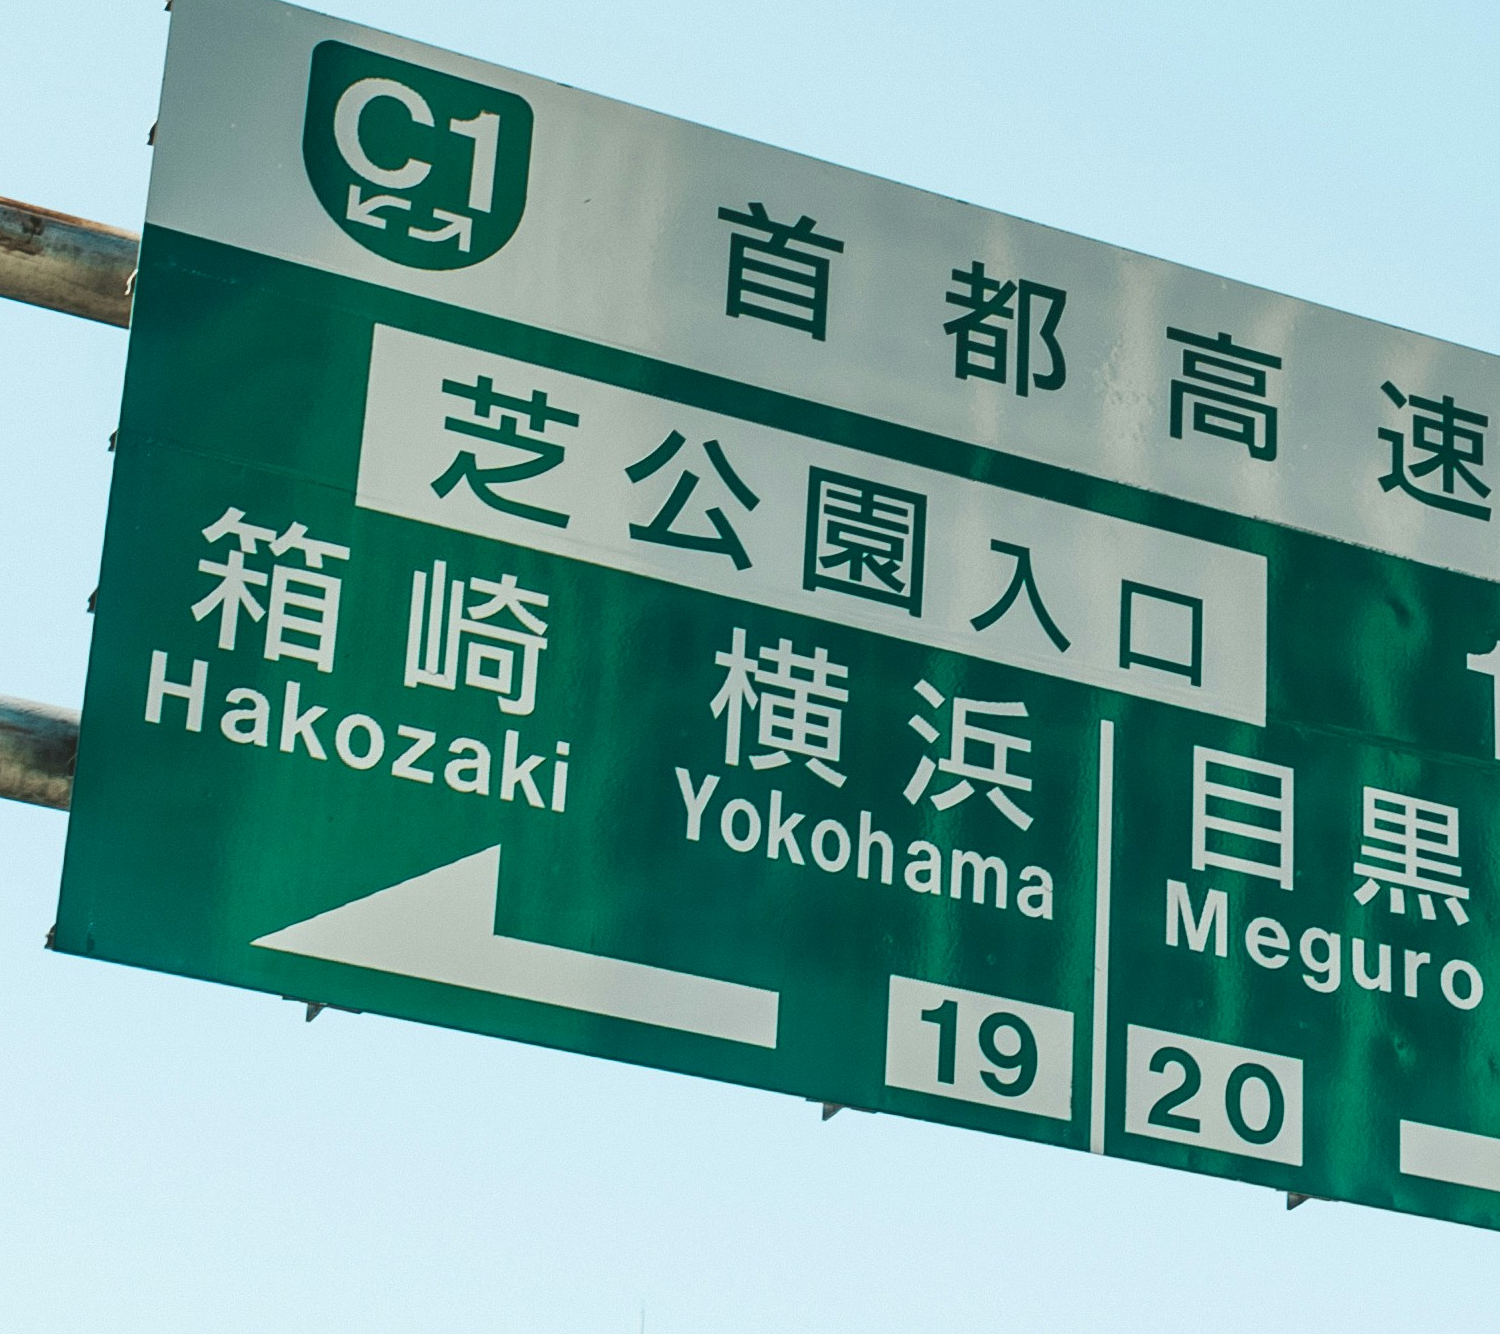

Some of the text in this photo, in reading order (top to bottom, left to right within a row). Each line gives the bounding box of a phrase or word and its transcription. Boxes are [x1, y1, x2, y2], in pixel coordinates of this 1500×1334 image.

[333, 77, 501, 213] C1
[717, 201, 1492, 522] 首都高速
[190, 506, 549, 716] 箱崎
[429, 374, 1204, 688] 芝公園入口
[144, 650, 569, 813] Hakozaki
[709, 627, 1034, 832] 横浜
[674, 766, 1055, 920] Yokohama
[1191, 745, 1471, 927] 目黒
[1166, 879, 1484, 1011] Meguro
[920, 998, 1039, 1097] 19
[1146, 1046, 1286, 1145] 20
